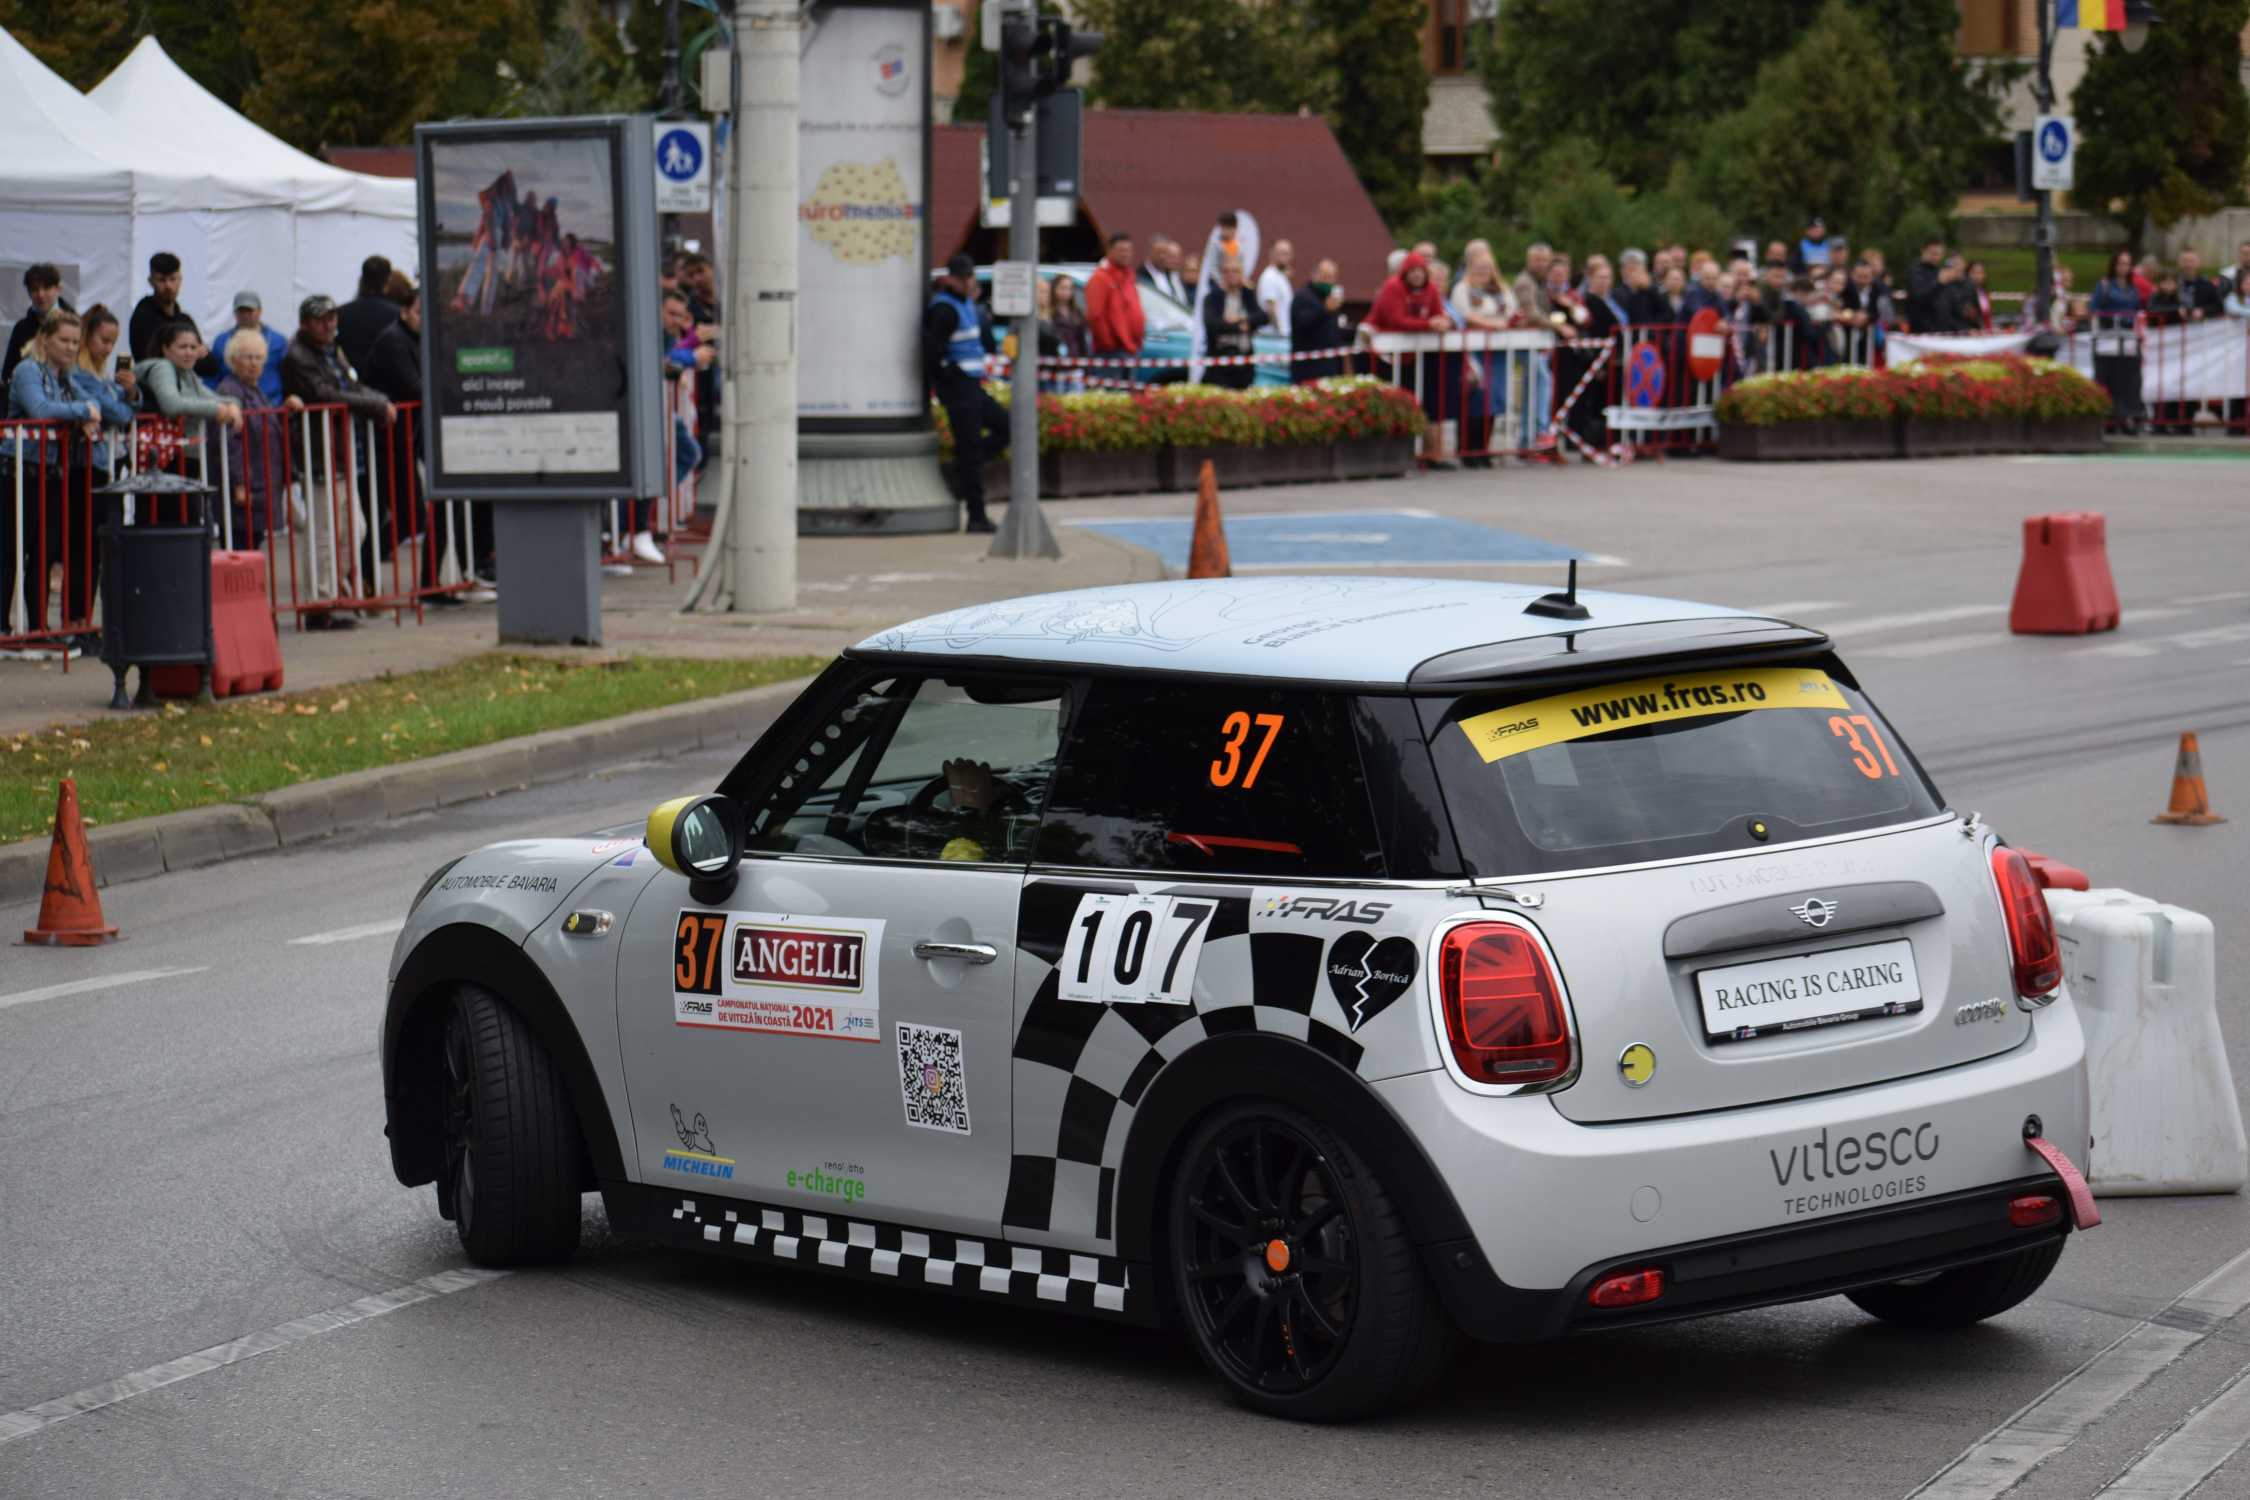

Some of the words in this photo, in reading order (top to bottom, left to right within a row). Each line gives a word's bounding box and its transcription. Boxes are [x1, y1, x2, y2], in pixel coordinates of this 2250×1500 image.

[1571, 682, 1767, 727] www.fras.ro
[1497, 718, 1539, 737] FRAS
[1210, 711, 1284, 788] 37
[1828, 714, 1899, 779] 37
[440, 875, 509, 890] AUTOMOBILE
[507, 875, 558, 892] BAVARIA
[1288, 897, 1393, 924] FRAS
[676, 915, 725, 990] 37
[736, 936, 859, 980] ANGELLI
[1075, 902, 1214, 993] 107
[1328, 964, 1364, 978] Adrian
[1716, 977, 1798, 1010] RACING
[1803, 974, 1822, 997] IS
[1827, 961, 1903, 993] CARING
[686, 1001, 713, 1013] FRAS
[717, 999, 759, 1011] CAMPIONATUL
[792, 1005, 834, 1031] 2021
[663, 1156, 734, 1180] MICHELIN
[786, 1166, 865, 1203] e-charge
[1784, 1175, 1927, 1216] TECHNOLOGIES
